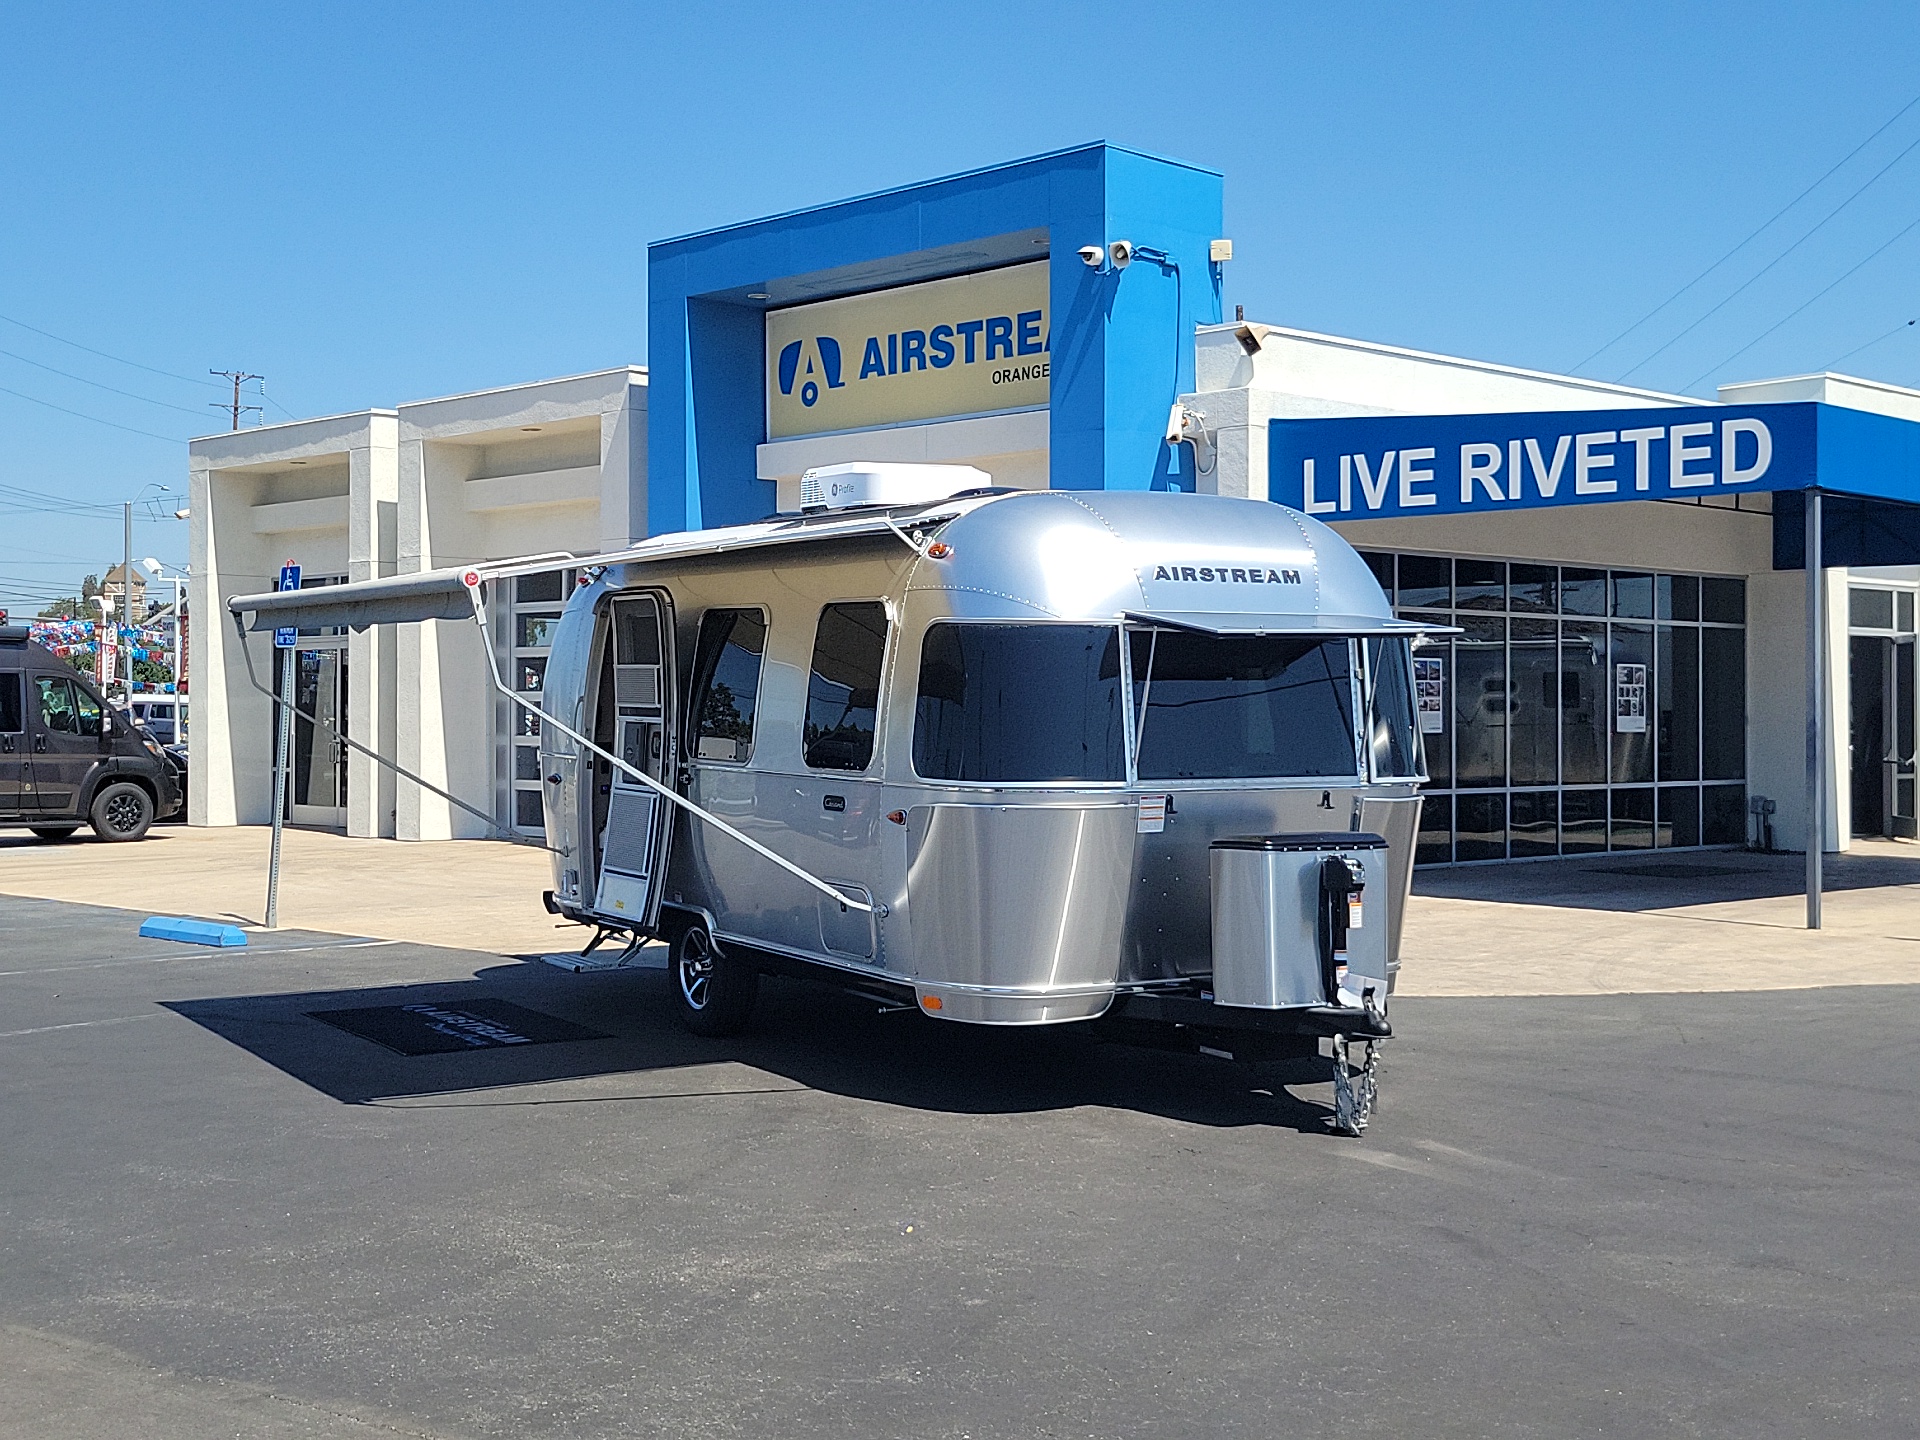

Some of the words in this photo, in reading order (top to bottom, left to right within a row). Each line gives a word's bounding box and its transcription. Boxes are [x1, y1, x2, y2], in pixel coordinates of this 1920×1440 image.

[858, 309, 1050, 380] AIRSTRE
[992, 363, 1050, 385] ORANGE
[1303, 447, 1436, 514] LIVE
[1460, 417, 1773, 503] RIVETED
[1154, 565, 1302, 585] AIRSTREAM
